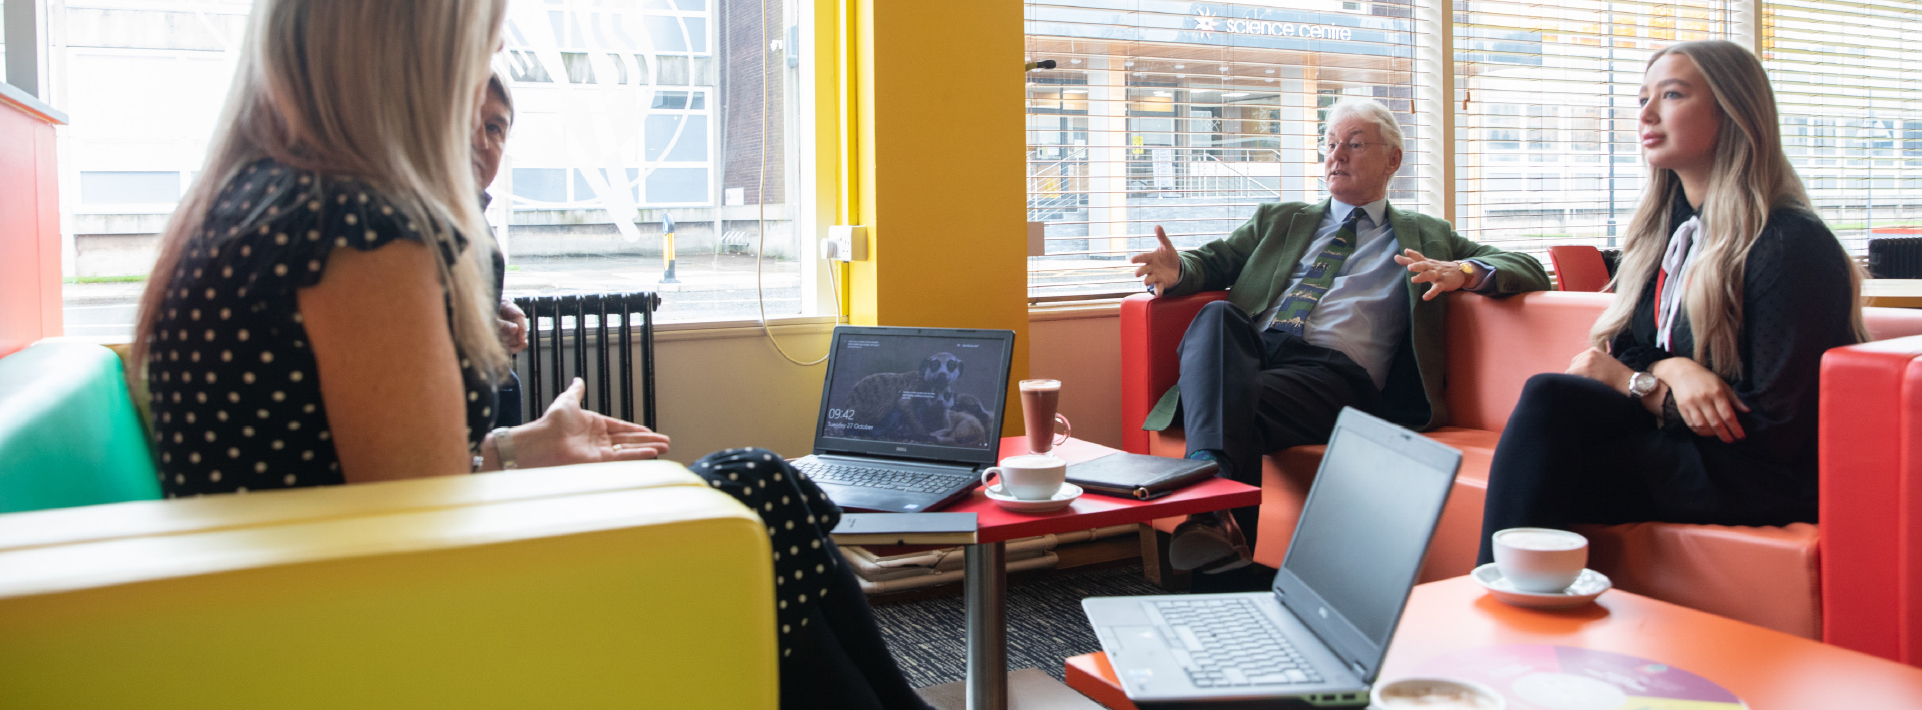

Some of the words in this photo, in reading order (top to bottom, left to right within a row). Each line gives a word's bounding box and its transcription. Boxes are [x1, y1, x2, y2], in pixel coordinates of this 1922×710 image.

[1226, 16, 1295, 37] science
[1299, 22, 1352, 41] centre
[828, 408, 855, 420] 09:42
[827, 421, 846, 429] Tuesday
